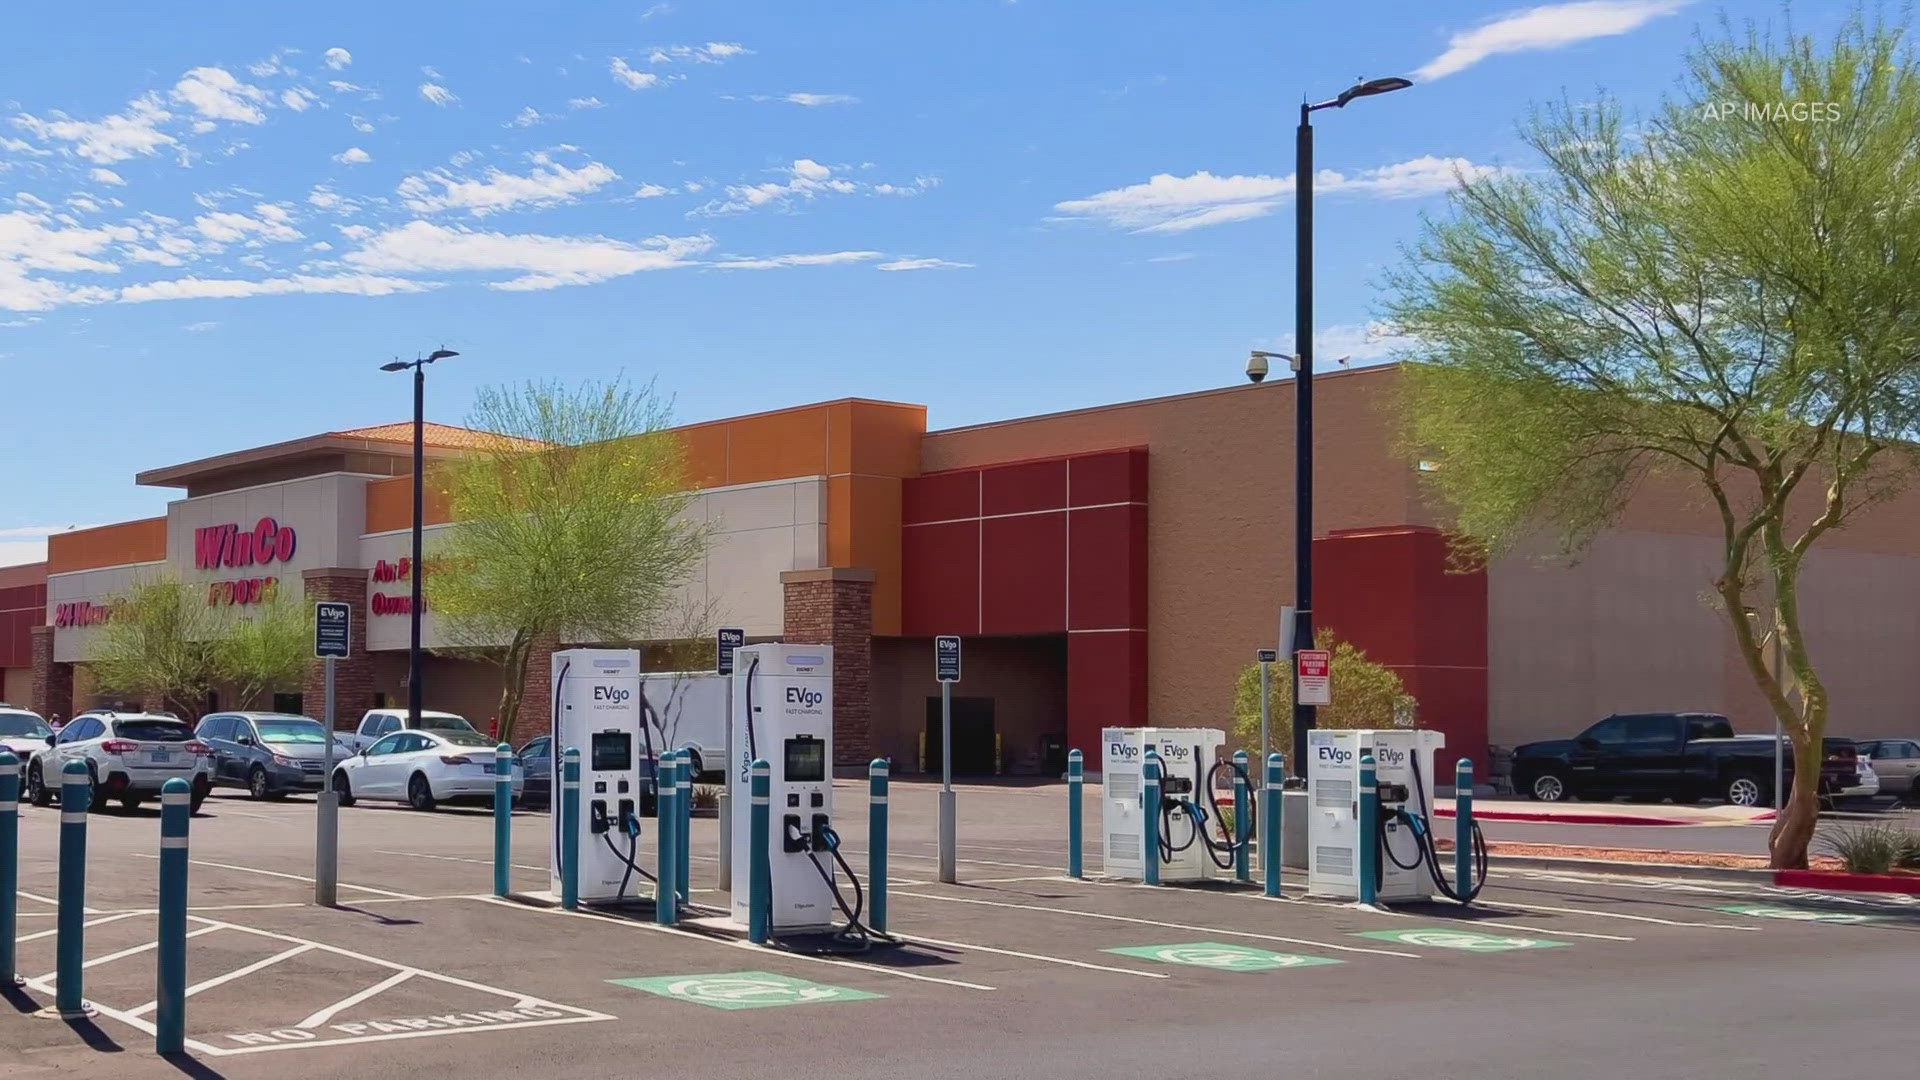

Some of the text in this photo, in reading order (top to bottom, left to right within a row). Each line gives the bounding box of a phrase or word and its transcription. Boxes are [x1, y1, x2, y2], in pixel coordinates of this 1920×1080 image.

[195, 516, 296, 569] WinCo
[372, 592, 427, 616] Own
[320, 607, 345, 619] EVgo
[721, 632, 741, 642] EVgo
[939, 640, 957, 650] EVgo
[594, 686, 630, 704] EVgo
[786, 687, 823, 708] EVgo
[1111, 743, 1139, 759] EVgo
[1164, 745, 1189, 759] EVgo
[1319, 747, 1352, 763] EVgo
[1379, 748, 1404, 764] EVgo
[741, 751, 751, 783] EVgo
[225, 1009, 562, 1044] NO PARKING
